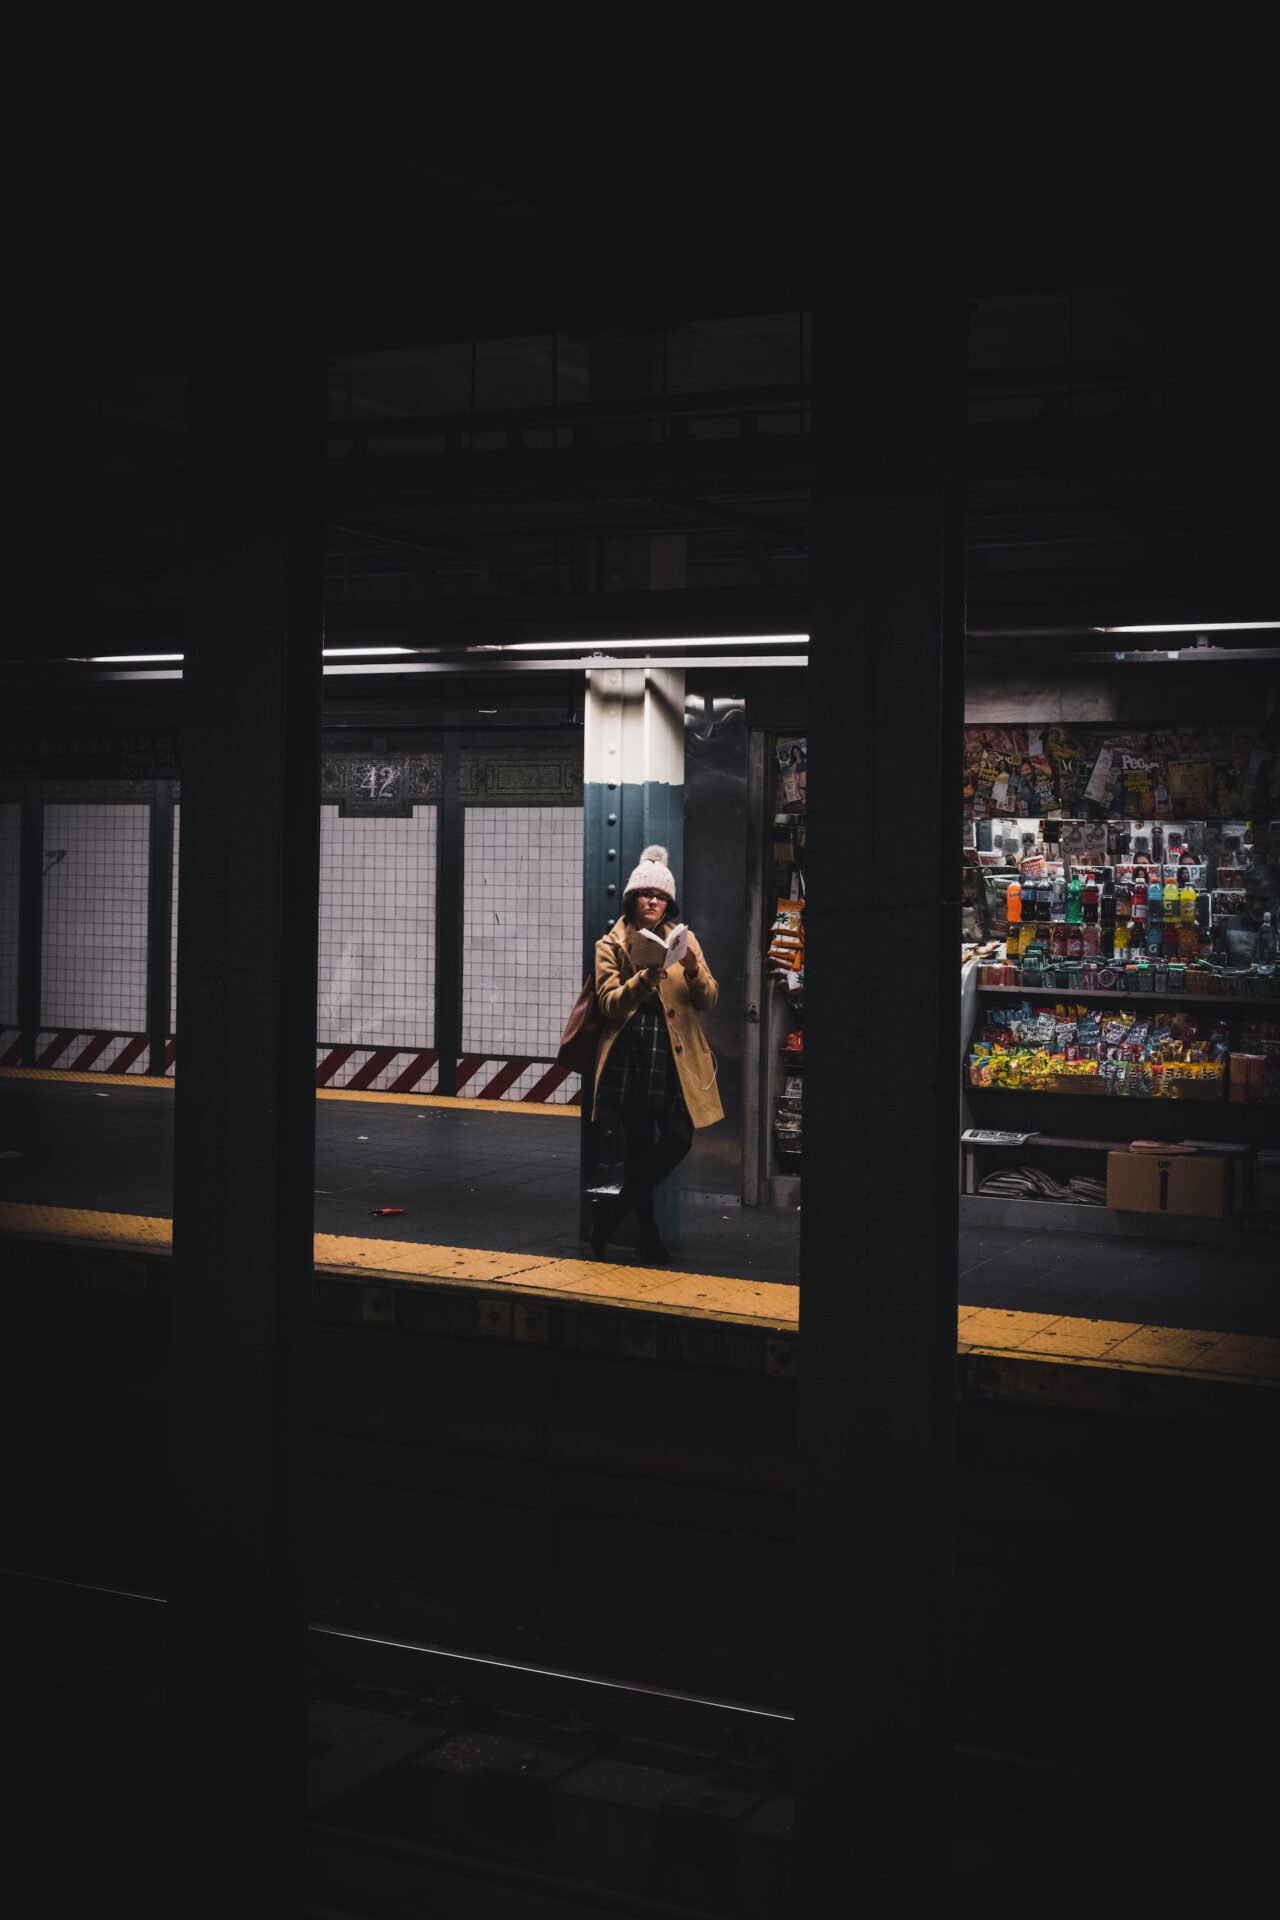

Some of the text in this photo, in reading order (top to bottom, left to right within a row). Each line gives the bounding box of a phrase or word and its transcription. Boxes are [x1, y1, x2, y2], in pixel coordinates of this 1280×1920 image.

[120, 765, 182, 778] Port Autho
[359, 766, 395, 798] 42
[1034, 782, 1055, 793] SEXIEST
[1116, 866, 1156, 874] GLAUR
[1164, 867, 1206, 878] SHPE
[1149, 944, 1158, 953] G
[1157, 1160, 1171, 1168] UP
